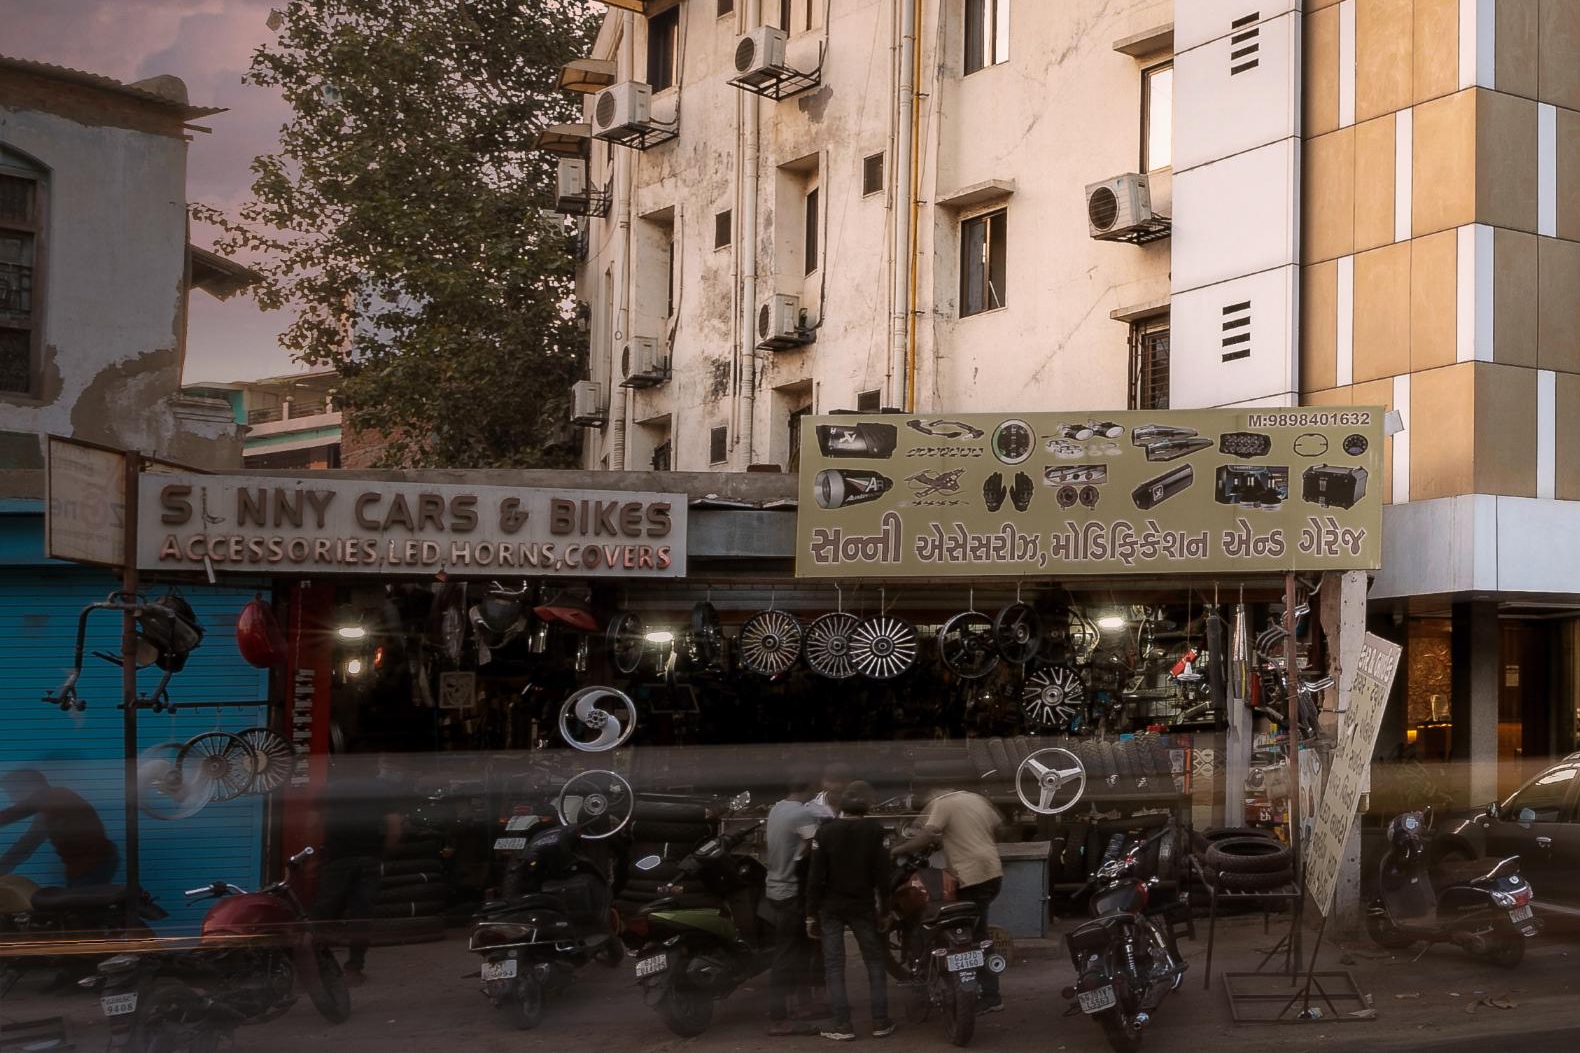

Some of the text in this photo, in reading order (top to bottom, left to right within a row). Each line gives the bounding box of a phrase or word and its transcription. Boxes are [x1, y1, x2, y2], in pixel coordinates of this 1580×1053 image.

[1248, 412, 1371, 427] M:9898401632
[160, 484, 673, 538] SNNY CARS & BIKES
[564, 543, 672, 570] COVERS
[811, 512, 902, 564] સન્ની
[1222, 517, 1286, 558] એન્ડ
[1298, 516, 1366, 557] ગેરેજ
